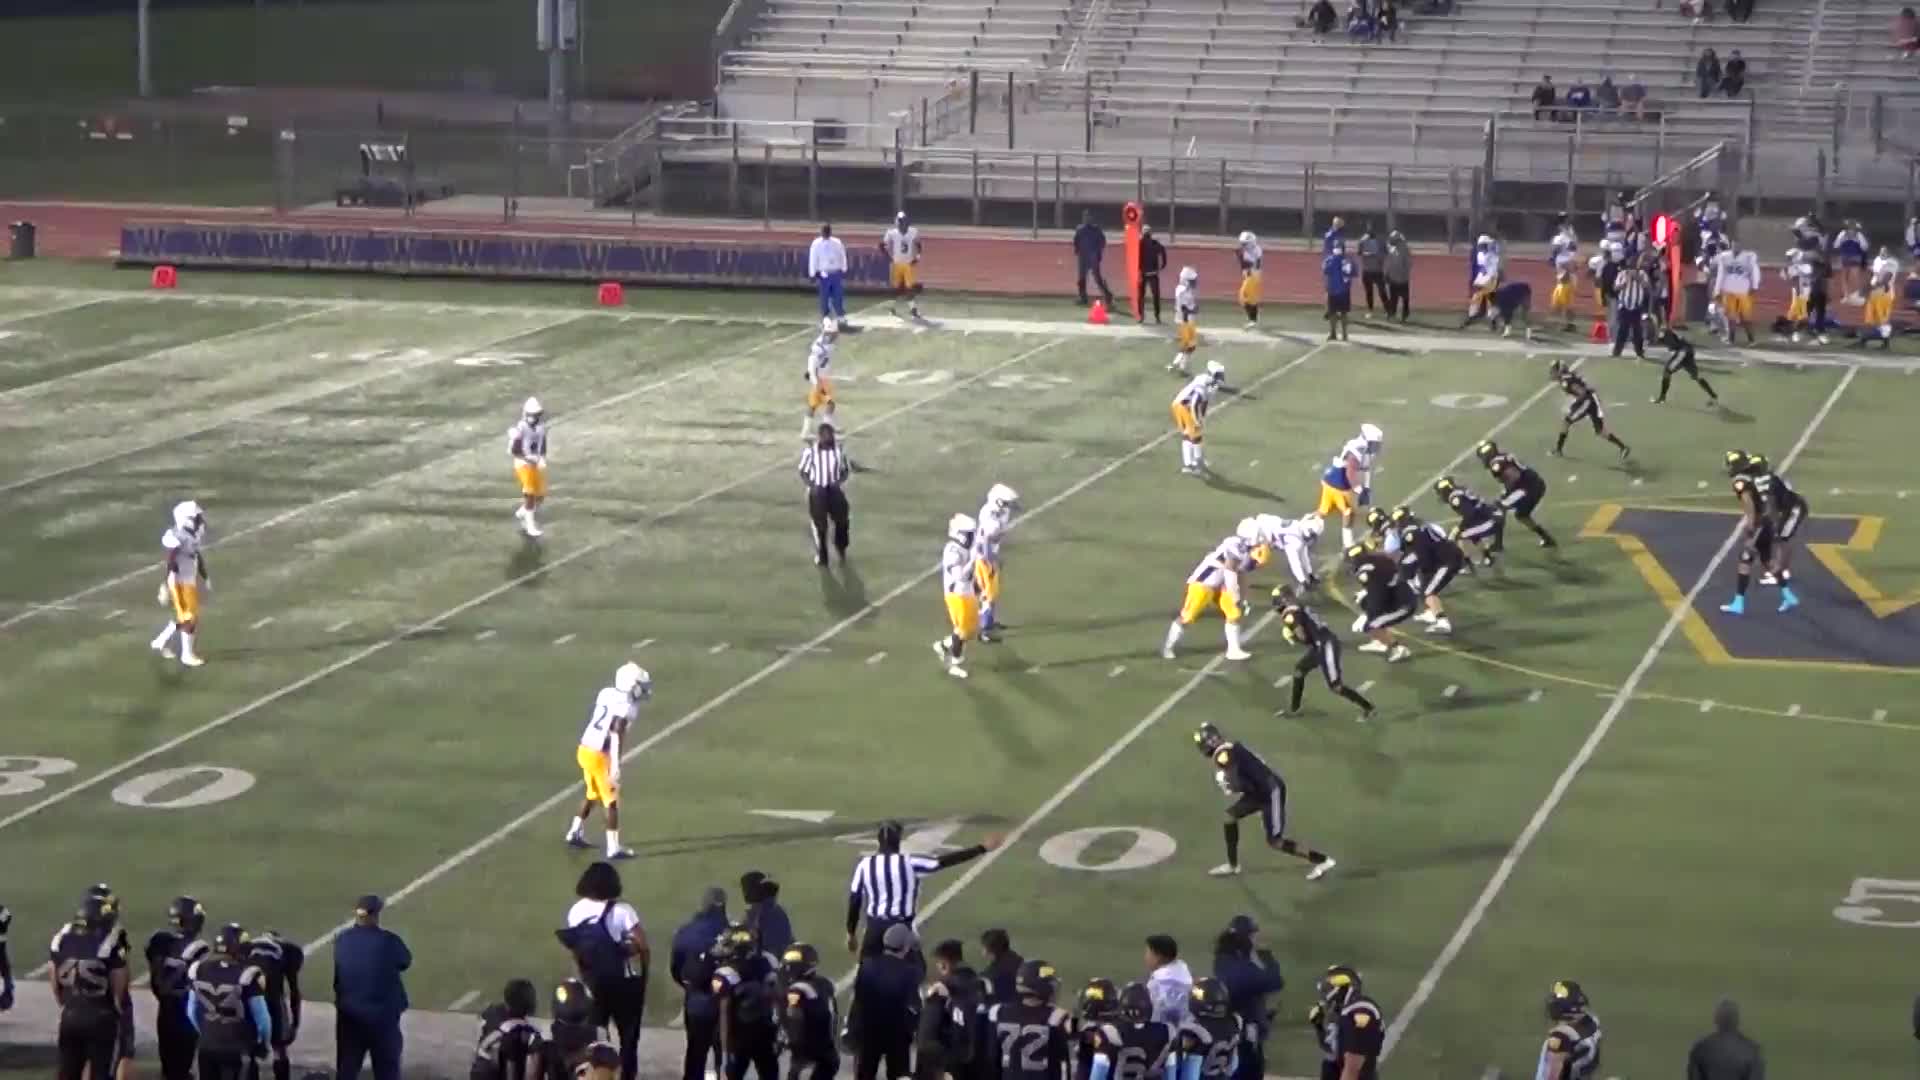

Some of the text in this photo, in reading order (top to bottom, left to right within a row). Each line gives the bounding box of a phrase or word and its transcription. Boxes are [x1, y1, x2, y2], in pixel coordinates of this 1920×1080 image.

[134, 227, 167, 255] W
[196, 231, 230, 256] W
[256, 232, 293, 259] W
[322, 232, 356, 261] W
[385, 237, 416, 263] W
[449, 239, 482, 267] W
[512, 241, 546, 270] W
[576, 241, 612, 271] W
[640, 245, 675, 272] W
[710, 248, 741, 273] W
[111, 766, 256, 809] 0
[1039, 826, 1177, 870] 0
[997, 1023, 1049, 1071] 72
